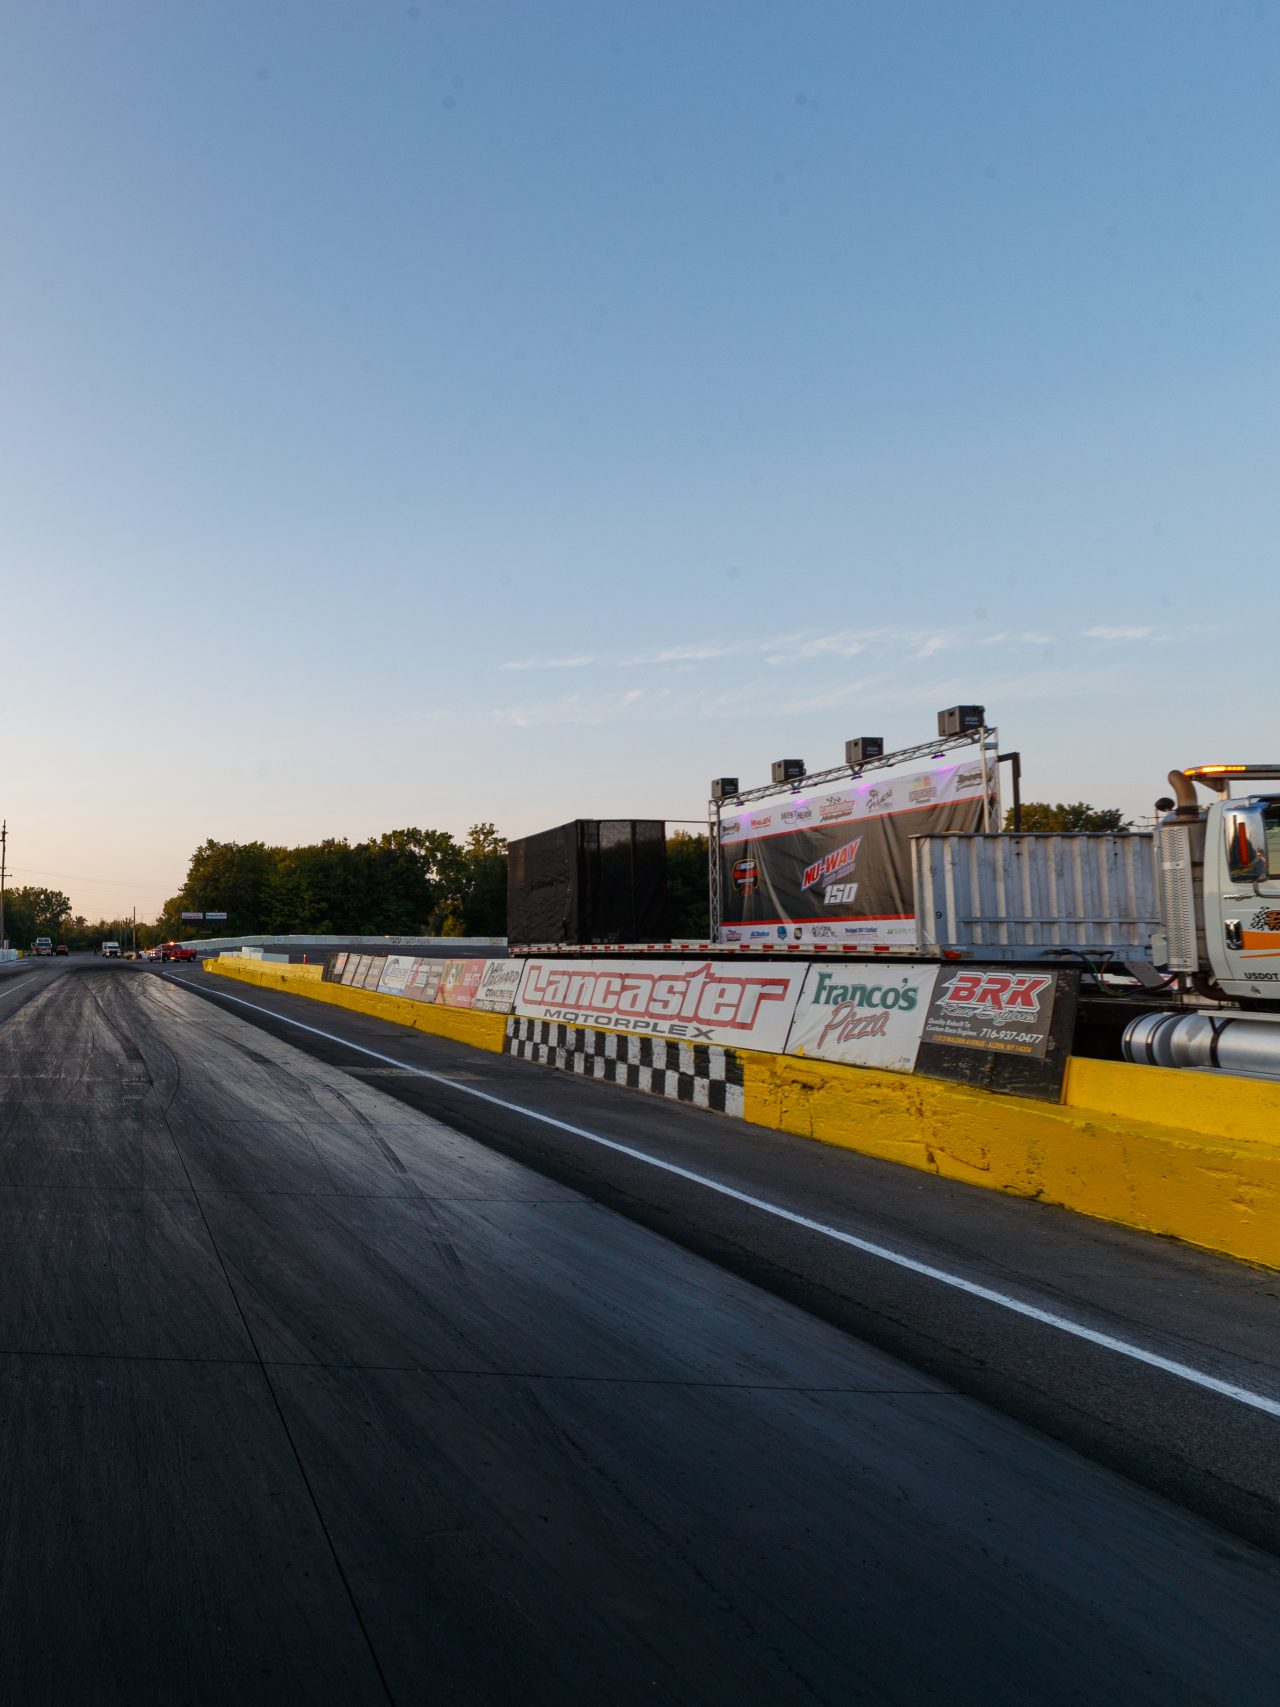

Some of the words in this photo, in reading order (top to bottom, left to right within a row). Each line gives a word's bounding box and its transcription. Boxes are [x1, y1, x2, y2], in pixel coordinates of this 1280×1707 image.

[802, 836, 862, 890] NU-WAY
[823, 882, 859, 906] 150
[811, 971, 919, 1012] Franco's
[935, 971, 1052, 1012] BRK
[1244, 972, 1279, 980] USDOT
[485, 988, 514, 998] CONCRETE
[523, 962, 791, 1030] Lancaster
[543, 1008, 716, 1041] MOTORPLEX
[816, 1000, 891, 1050] Pizza
[940, 1003, 976, 1018] Race
[979, 1028, 1045, 1044] 716-937-0477
